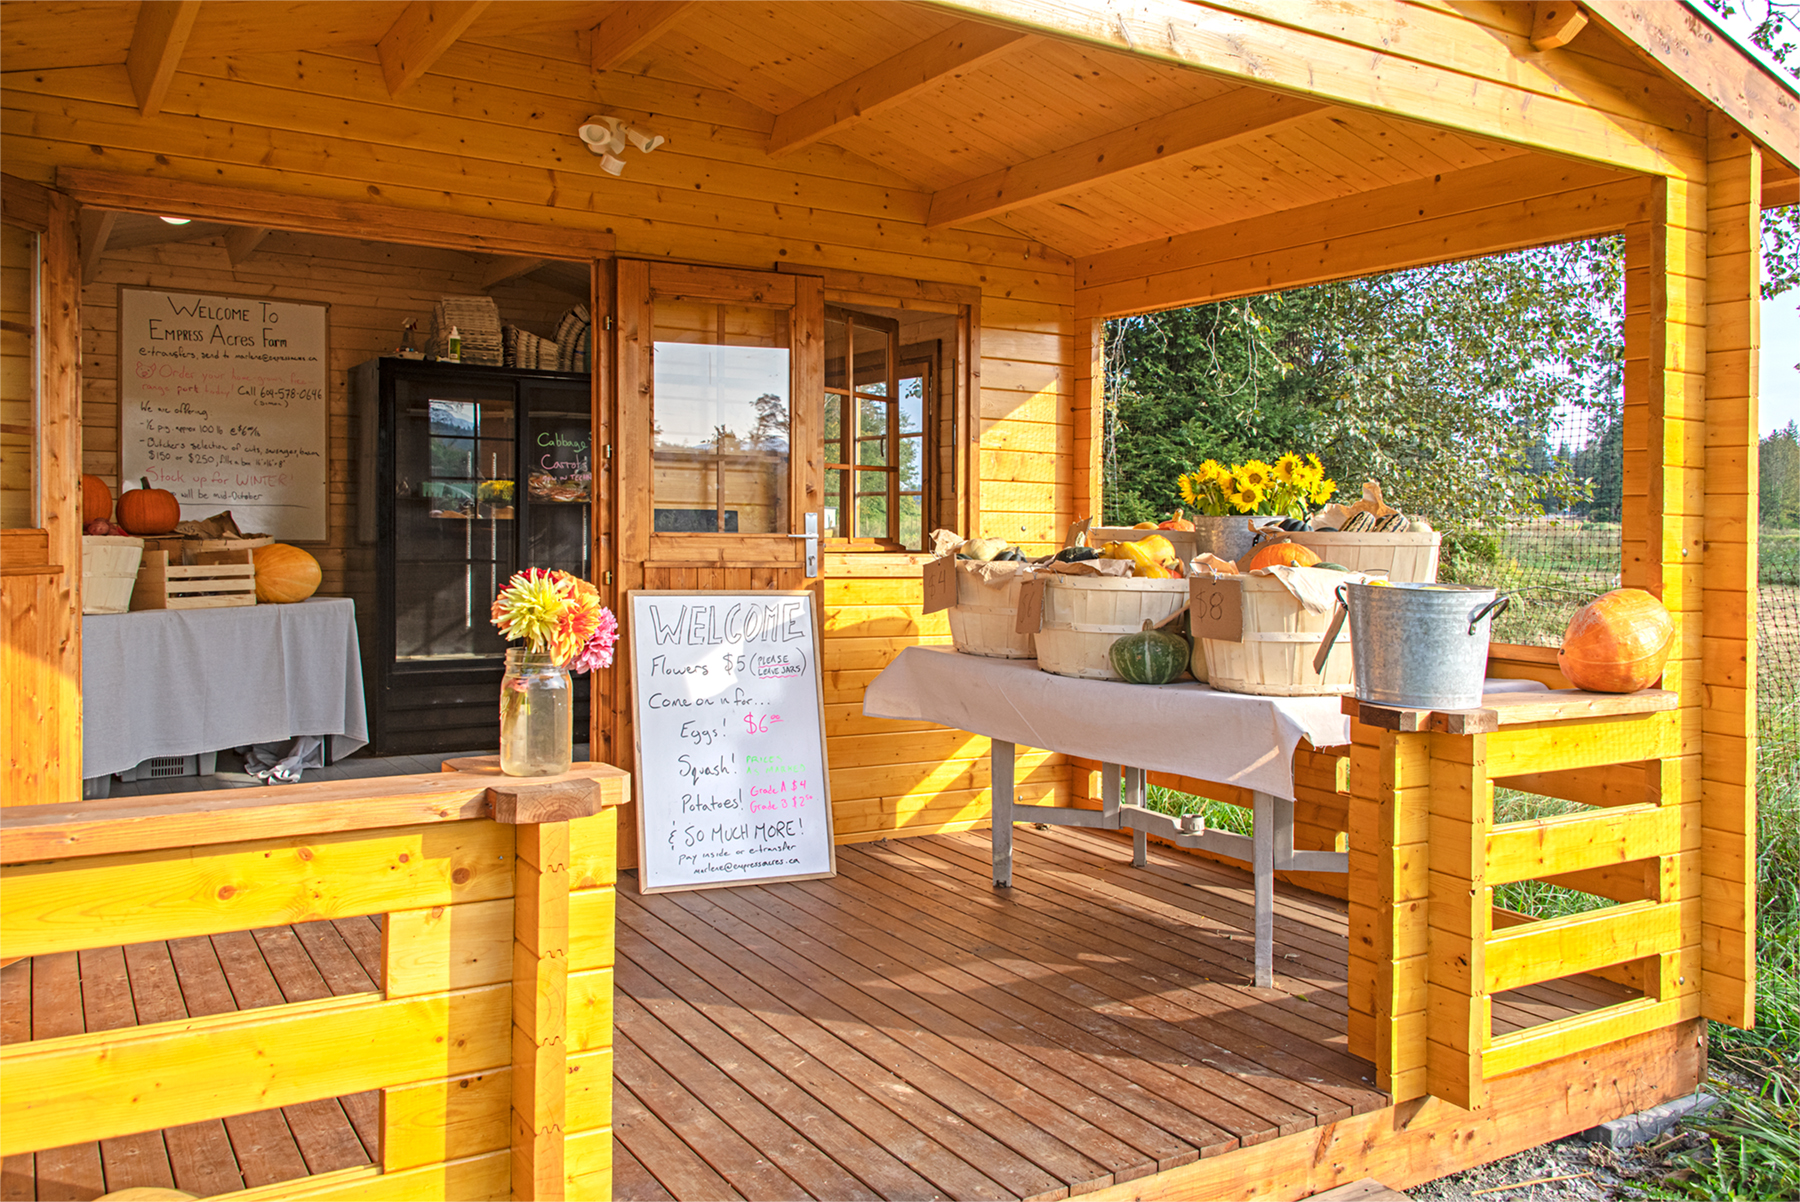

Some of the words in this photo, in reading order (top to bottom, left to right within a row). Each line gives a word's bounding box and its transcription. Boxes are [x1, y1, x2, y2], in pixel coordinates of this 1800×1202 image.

[201, 350, 220, 359] send
[222, 350, 230, 359] to
[159, 364, 195, 379] Order
[202, 373, 226, 382] your
[142, 384, 170, 397] range
[237, 386, 256, 396] Call
[260, 386, 323, 401] 604-578-0646
[140, 400, 153, 412] We
[199, 425, 214, 434] 100
[190, 440, 229, 451] selection
[231, 442, 242, 451] of
[148, 450, 171, 461] $150
[145, 465, 185, 484] Stock
[192, 475, 208, 489] up
[211, 471, 229, 484] for
[181, 488, 194, 500] will
[197, 489, 209, 499] be
[213, 490, 263, 501] mid-October
[1195, 589, 1225, 622] $8
[649, 602, 806, 646] WELCOME
[651, 654, 709, 677] Flowers
[722, 652, 747, 676] $5
[648, 692, 692, 710] Come
[695, 697, 715, 706] on
[680, 718, 727, 746] Eggs!
[677, 753, 738, 786] Squash!
[746, 754, 783, 764] PRICES
[681, 788, 744, 814] Potatoes!
[750, 785, 779, 797] Grade
[780, 780, 788, 793] A
[749, 800, 779, 814] Grade
[684, 825, 705, 847] SO
[711, 823, 749, 844] MUCH
[753, 817, 805, 842] MORE!
[702, 848, 731, 859] inside
